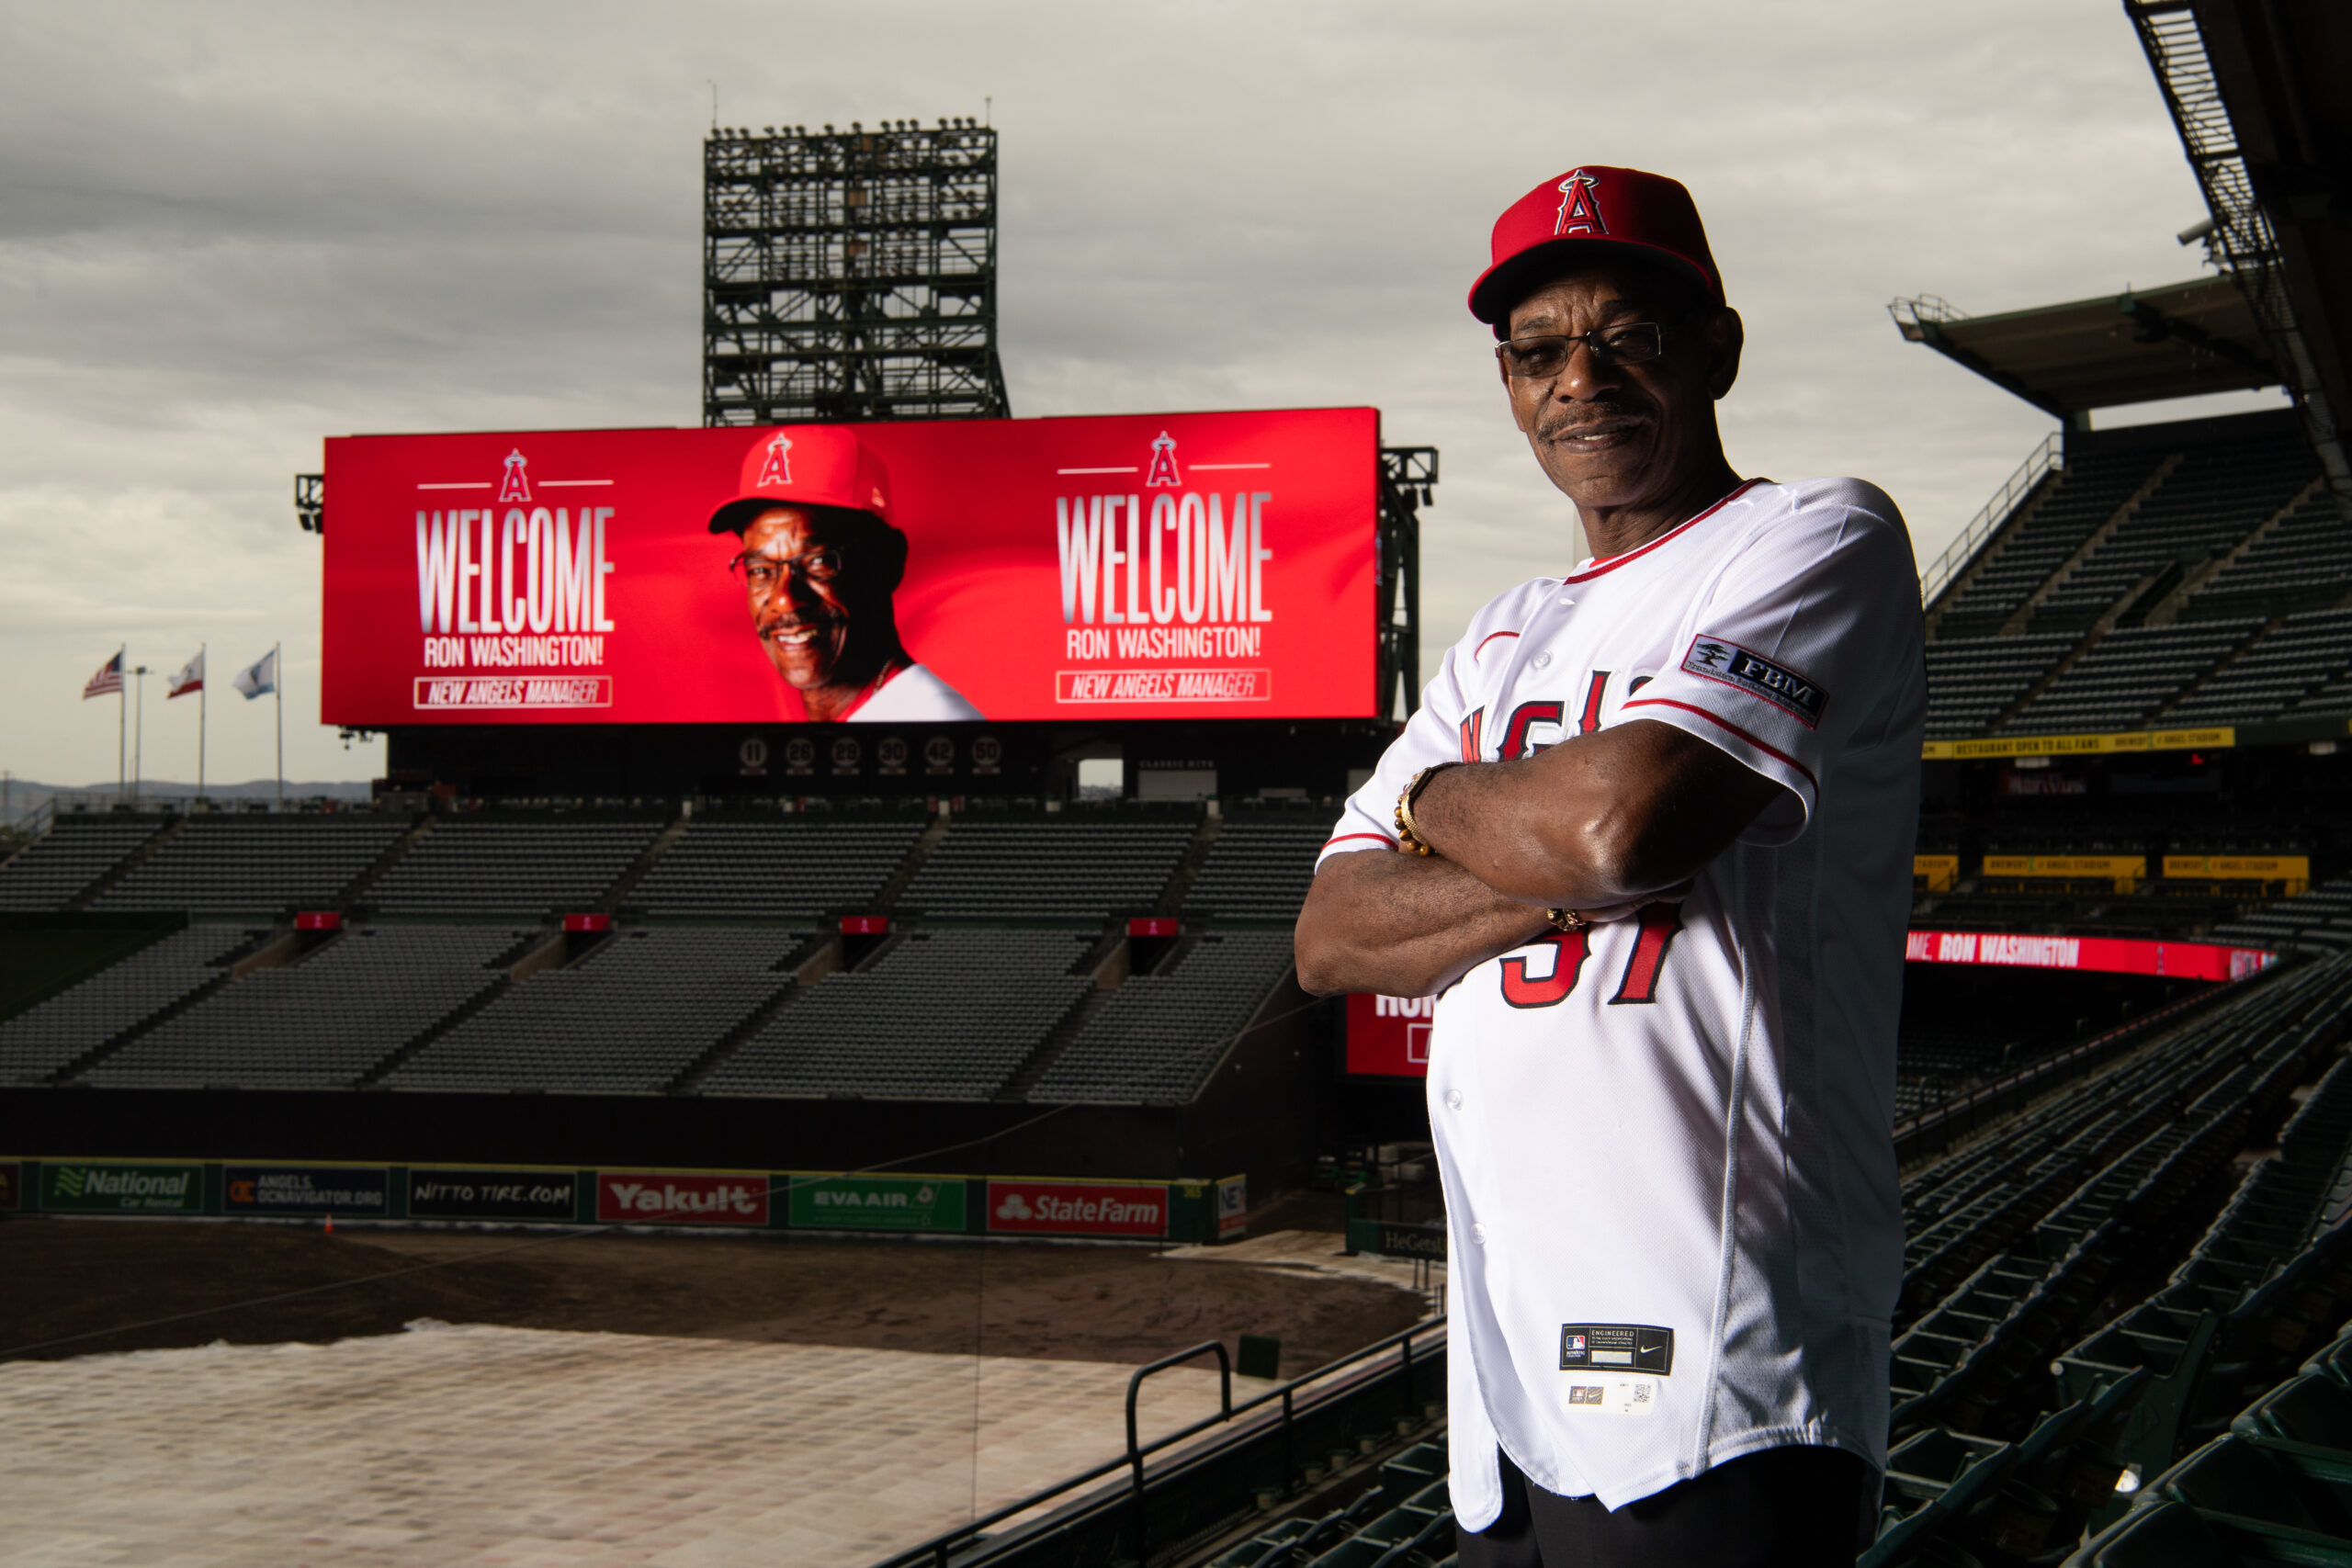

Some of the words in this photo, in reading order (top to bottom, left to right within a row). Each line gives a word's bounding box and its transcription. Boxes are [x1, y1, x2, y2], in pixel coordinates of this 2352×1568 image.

[415, 506, 615, 634] WELCOME
[1056, 492, 1272, 624] WELCOME
[424, 637, 466, 668] RON
[469, 635, 604, 667] WASHINGTON!
[1067, 628, 1110, 660] RON
[1116, 626, 1261, 659] WASHINGTON!
[427, 682, 467, 705] NEW
[465, 681, 525, 704] ANGELS
[525, 680, 600, 704] MANAGER
[1070, 675, 1112, 698] NEW
[1112, 674, 1175, 698] ANGELS
[1176, 673, 1256, 697] MANAGER
[1739, 657, 1816, 706] FBM
[746, 743, 762, 761] 11
[789, 743, 809, 761] 26
[835, 743, 856, 761] 29
[881, 743, 904, 761] 30
[928, 742, 949, 760] 42
[976, 742, 997, 760] 50
[1956, 742, 2013, 755] RESTAURANT
[2016, 740, 2040, 752] OPEN
[2075, 737, 2099, 750] FANS
[1938, 933, 1977, 963] RON
[1979, 934, 2080, 968] WASHINGTON
[85, 1170, 190, 1195] National
[415, 1181, 475, 1201] NITTO
[480, 1184, 571, 1205] TIRE.COM
[119, 1197, 141, 1208] Car
[144, 1197, 185, 1208] Rental
[258, 1190, 383, 1206] OCNAVIGATOR.ORG
[609, 1183, 758, 1214] Yakult
[1034, 1194, 1159, 1224] StateFarm
